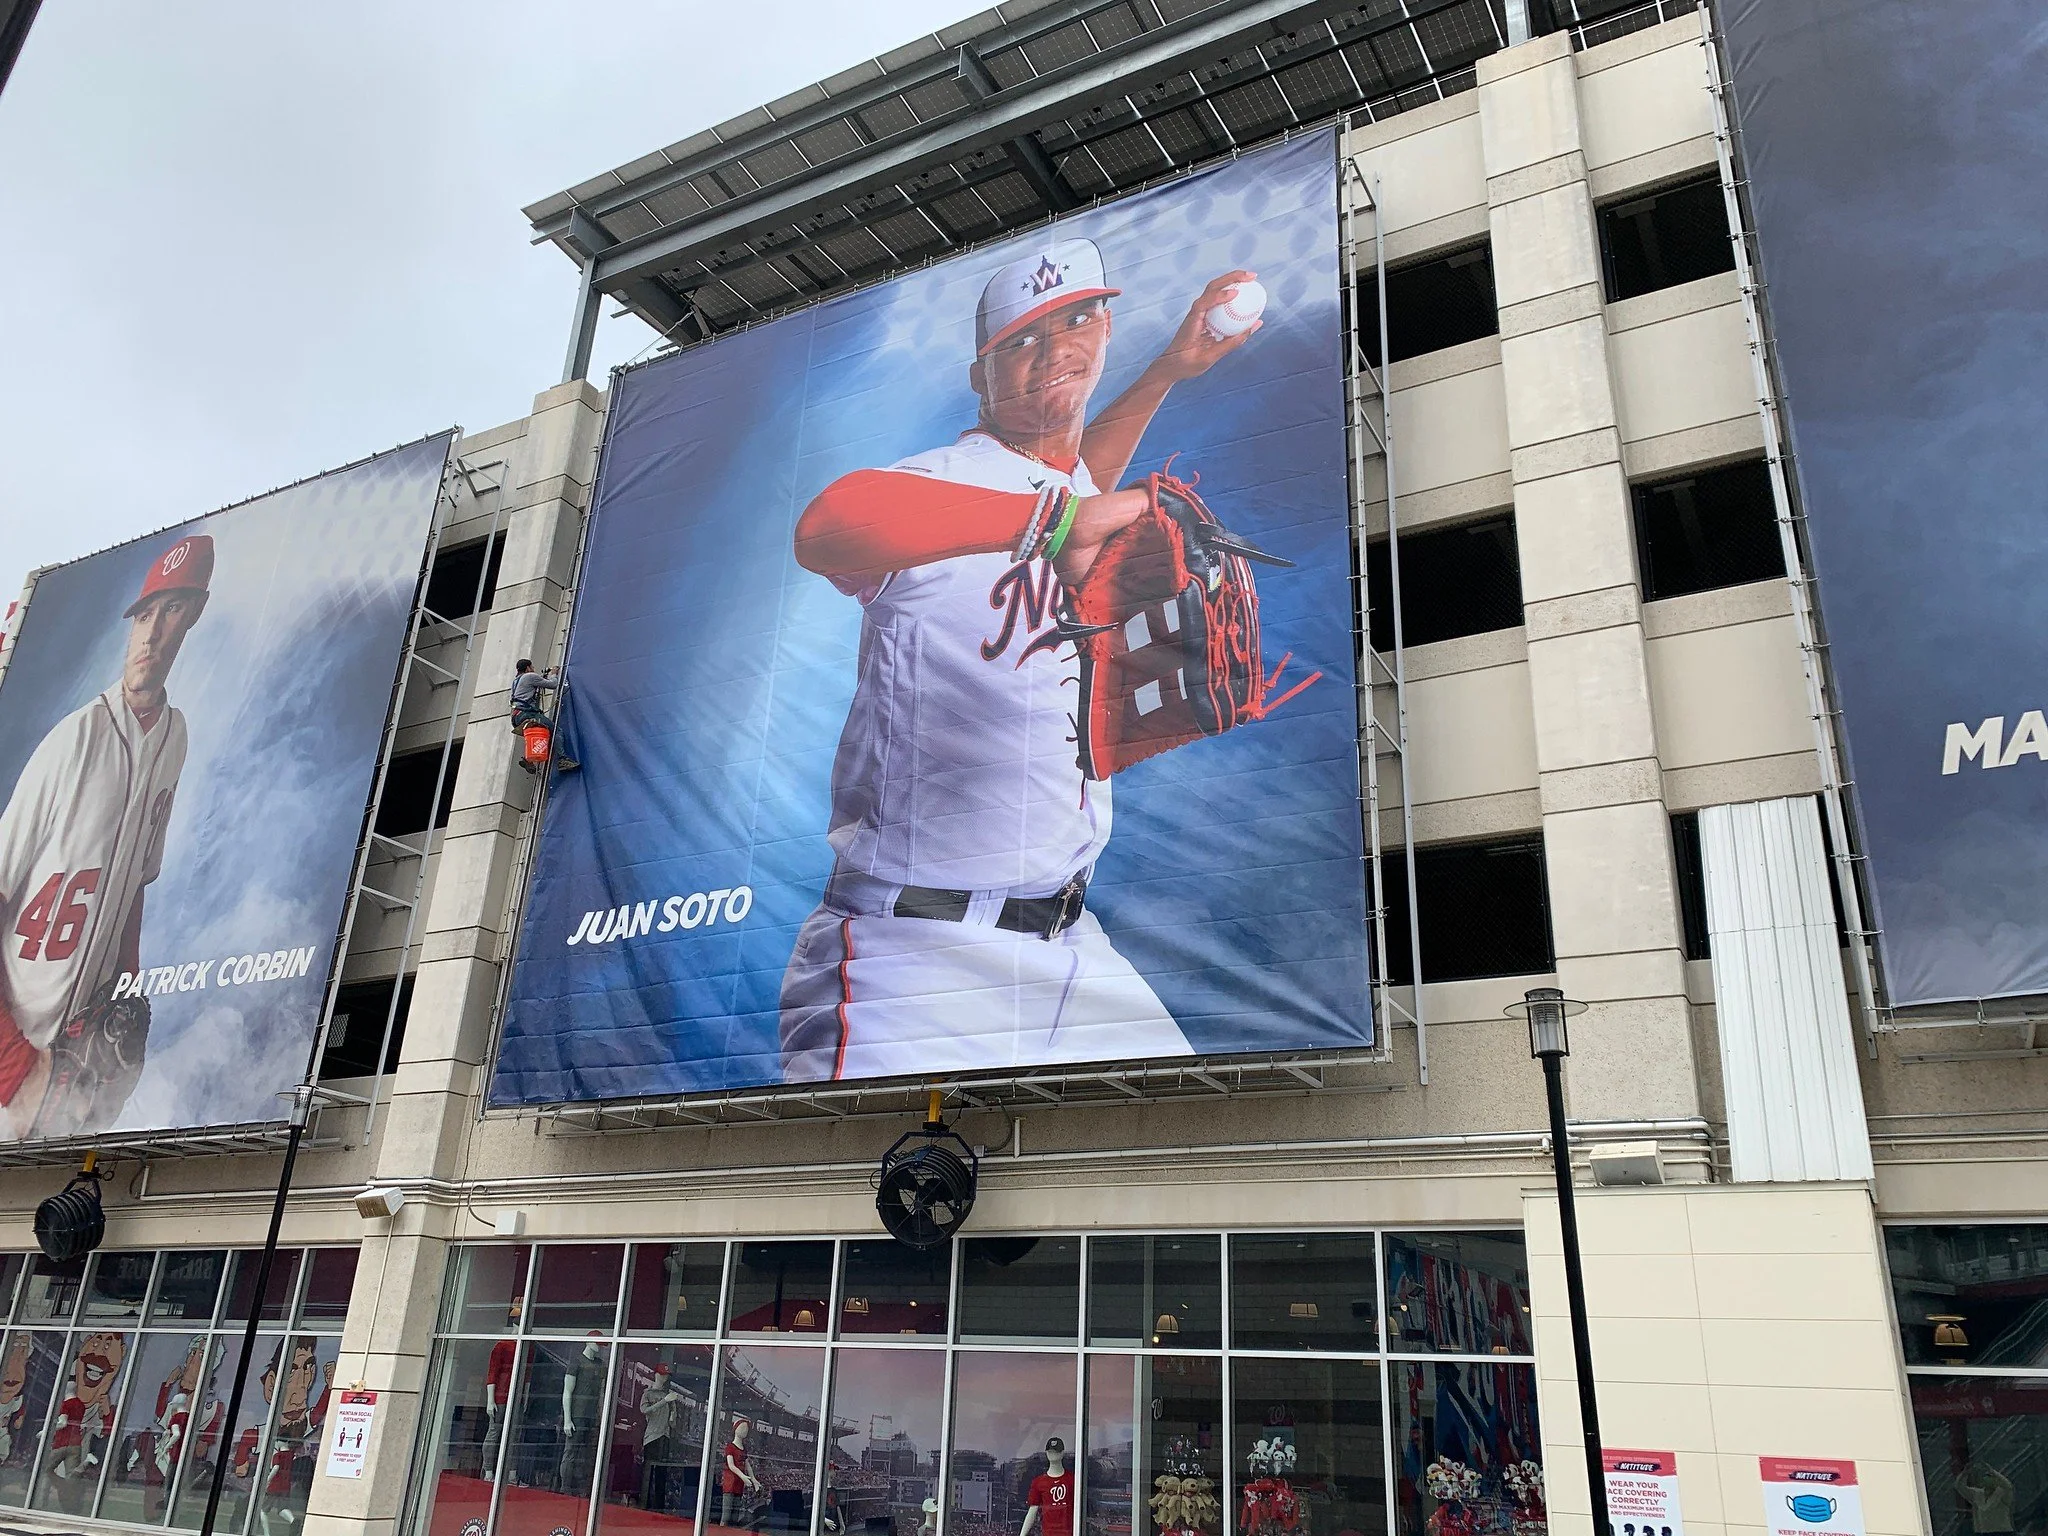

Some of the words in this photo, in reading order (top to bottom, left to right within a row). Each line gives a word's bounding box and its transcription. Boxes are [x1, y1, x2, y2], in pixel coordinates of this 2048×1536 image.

[14, 867, 103, 962] 46
[566, 899, 659, 946] JUAN
[656, 885, 753, 933] SOTO
[110, 959, 216, 1001] PATRICK
[216, 945, 317, 987] CORBIN
[1795, 1472, 1833, 1481] NATITUDE
[1609, 1480, 1634, 1488] WEAR
[1636, 1481, 1659, 1489] YOUR
[1050, 1484, 1066, 1502] W
[1607, 1488, 1623, 1496] ACE
[1625, 1489, 1668, 1499] COVERING
[1612, 1496, 1659, 1506] CORRECTLY
